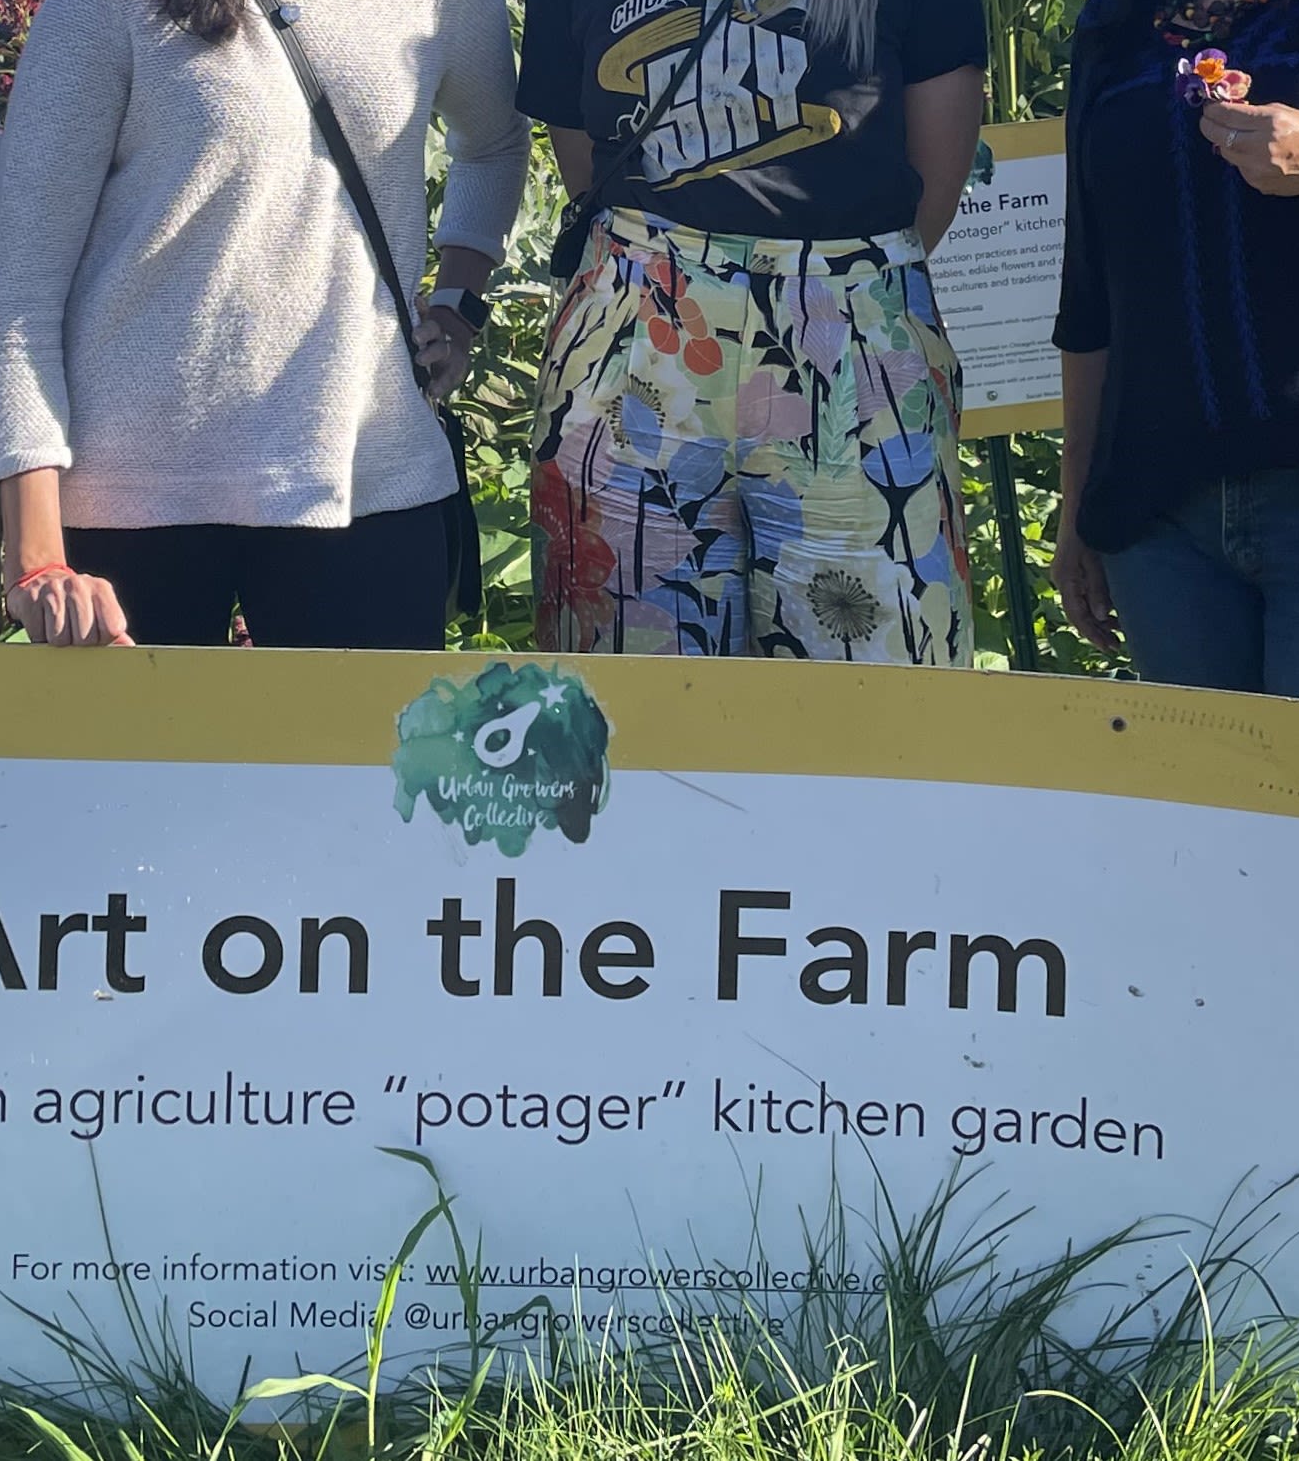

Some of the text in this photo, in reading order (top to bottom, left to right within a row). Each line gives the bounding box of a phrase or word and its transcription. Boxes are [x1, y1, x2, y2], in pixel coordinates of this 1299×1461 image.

[959, 193, 1049, 215] the Farm
[1015, 216, 1065, 232] kitchen
[929, 242, 1063, 265] oduction practices and cont
[968, 262, 999, 275] edible
[1001, 259, 1035, 272] flowers
[1037, 256, 1056, 268] and
[950, 279, 988, 291] cultures
[990, 276, 1009, 287] and
[1011, 272, 1056, 285] traditions
[438, 773, 576, 803] Urban Growers
[463, 803, 550, 831] Collective
[202, 915, 369, 994] on
[427, 878, 654, 1000] the
[717, 889, 1066, 1017] Farm
[33, 1070, 356, 1139] agriculture
[714, 1078, 925, 1138] kitchen
[951, 1097, 1164, 1160] garden
[12, 1253, 63, 1281] For
[73, 1261, 151, 1282] more
[163, 1253, 337, 1282] information
[189, 1301, 277, 1329] Social
